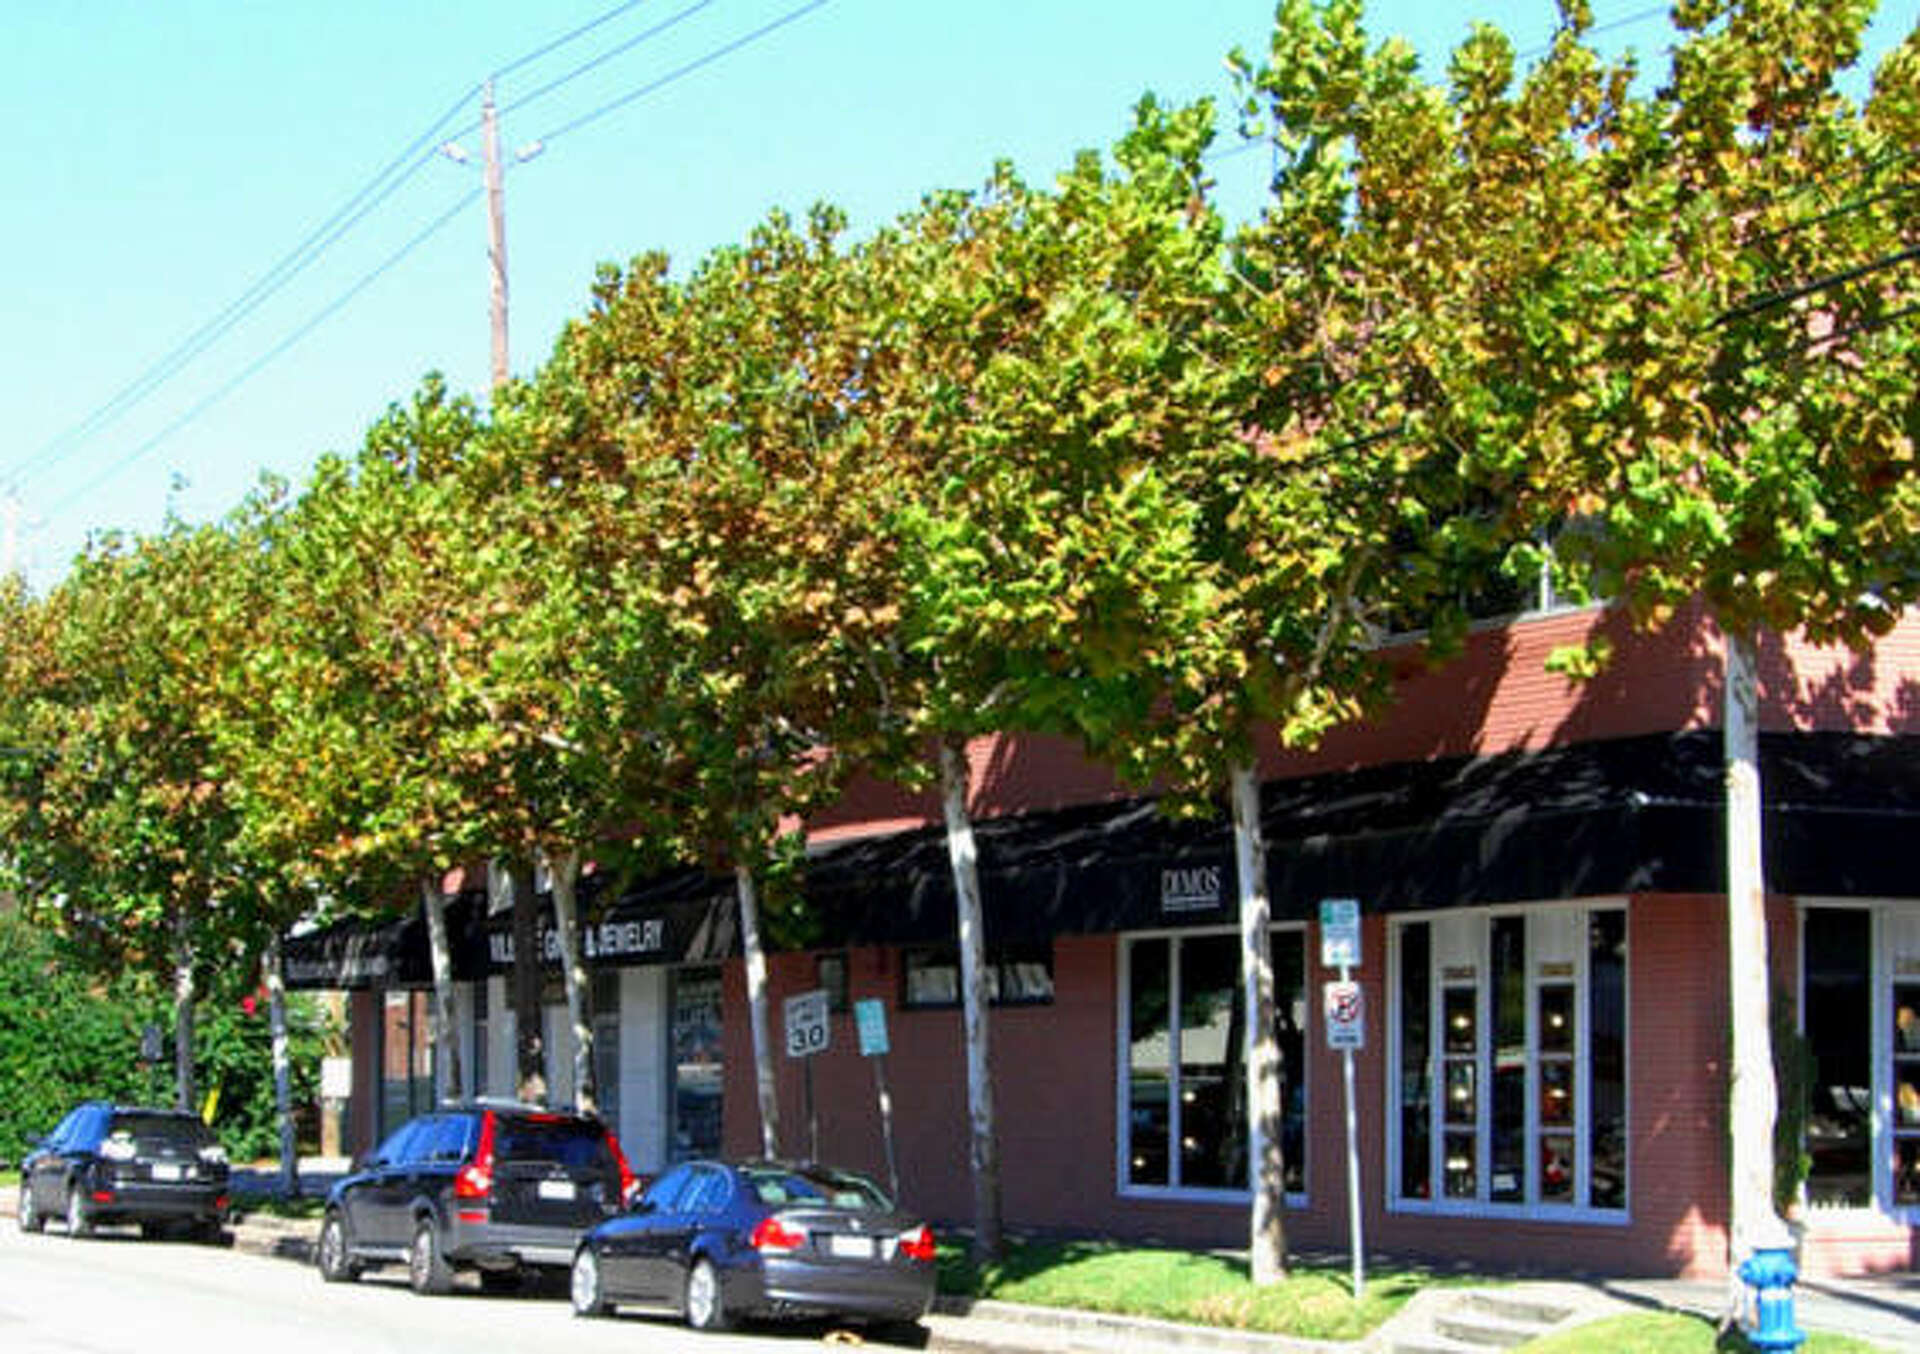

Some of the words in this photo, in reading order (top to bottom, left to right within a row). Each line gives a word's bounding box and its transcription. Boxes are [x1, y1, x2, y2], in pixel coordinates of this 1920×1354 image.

[490, 928, 543, 962] VILLE
[599, 920, 664, 955] JEWELRY
[791, 1024, 824, 1052] 30
